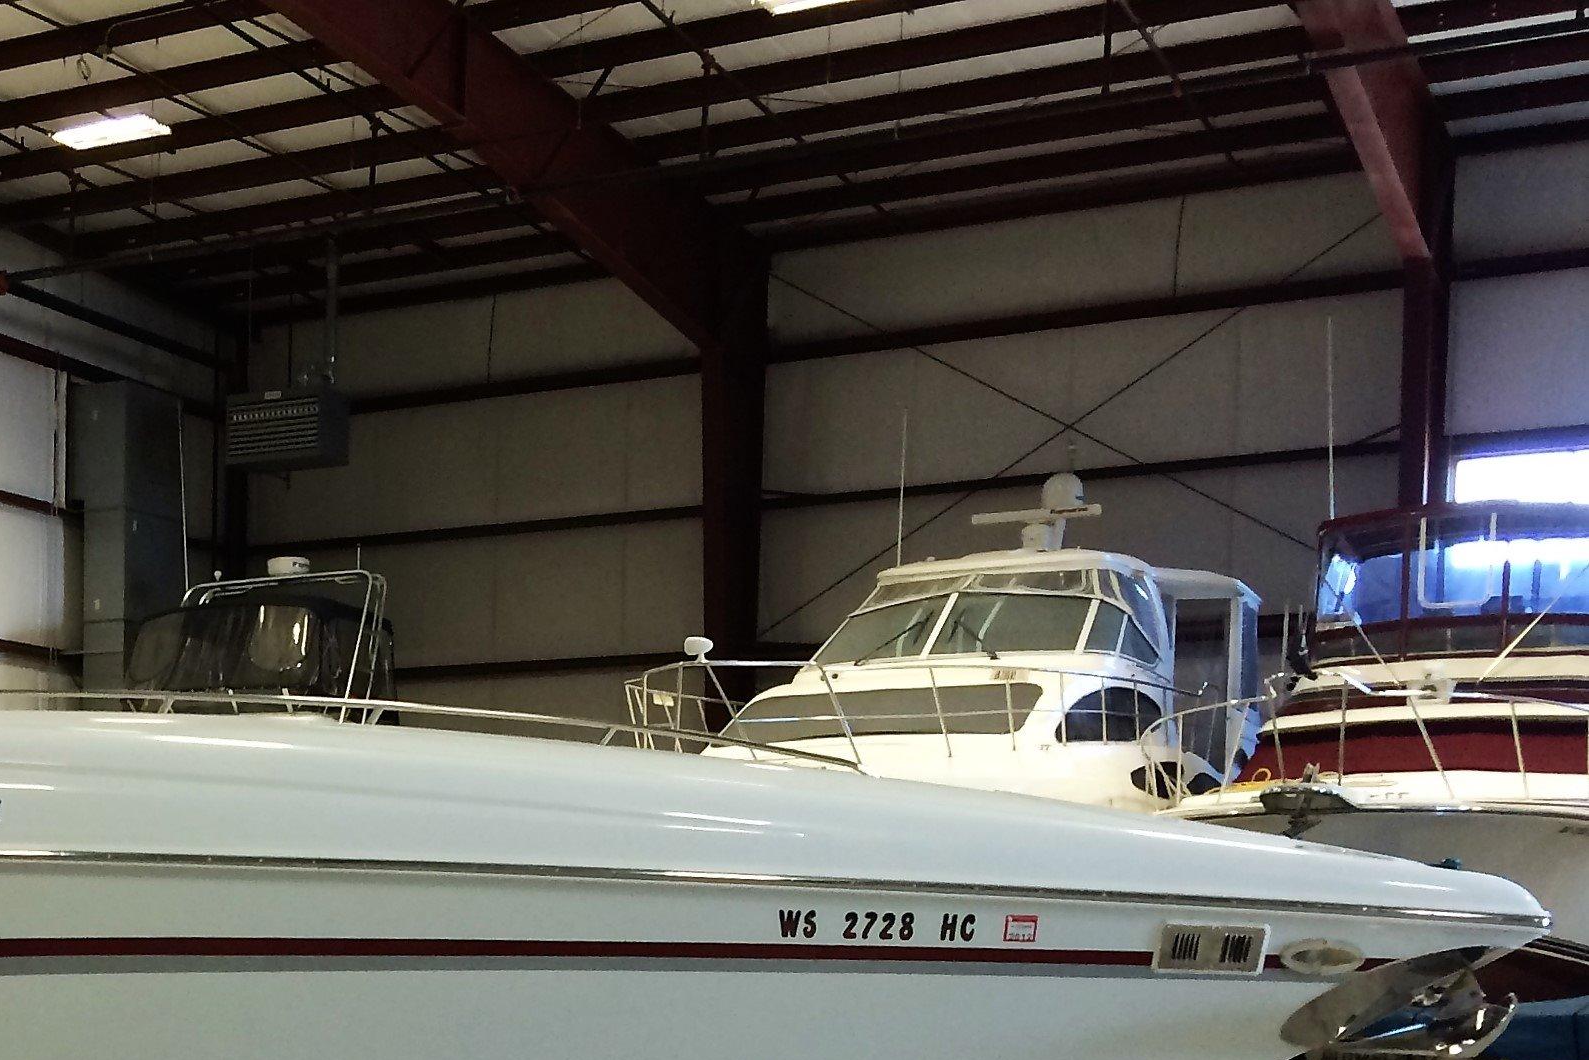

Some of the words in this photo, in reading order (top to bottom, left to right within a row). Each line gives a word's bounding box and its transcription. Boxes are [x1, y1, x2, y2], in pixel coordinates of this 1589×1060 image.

[778, 909, 817, 939] WS
[842, 911, 915, 941] 2728
[939, 913, 976, 942] HC
